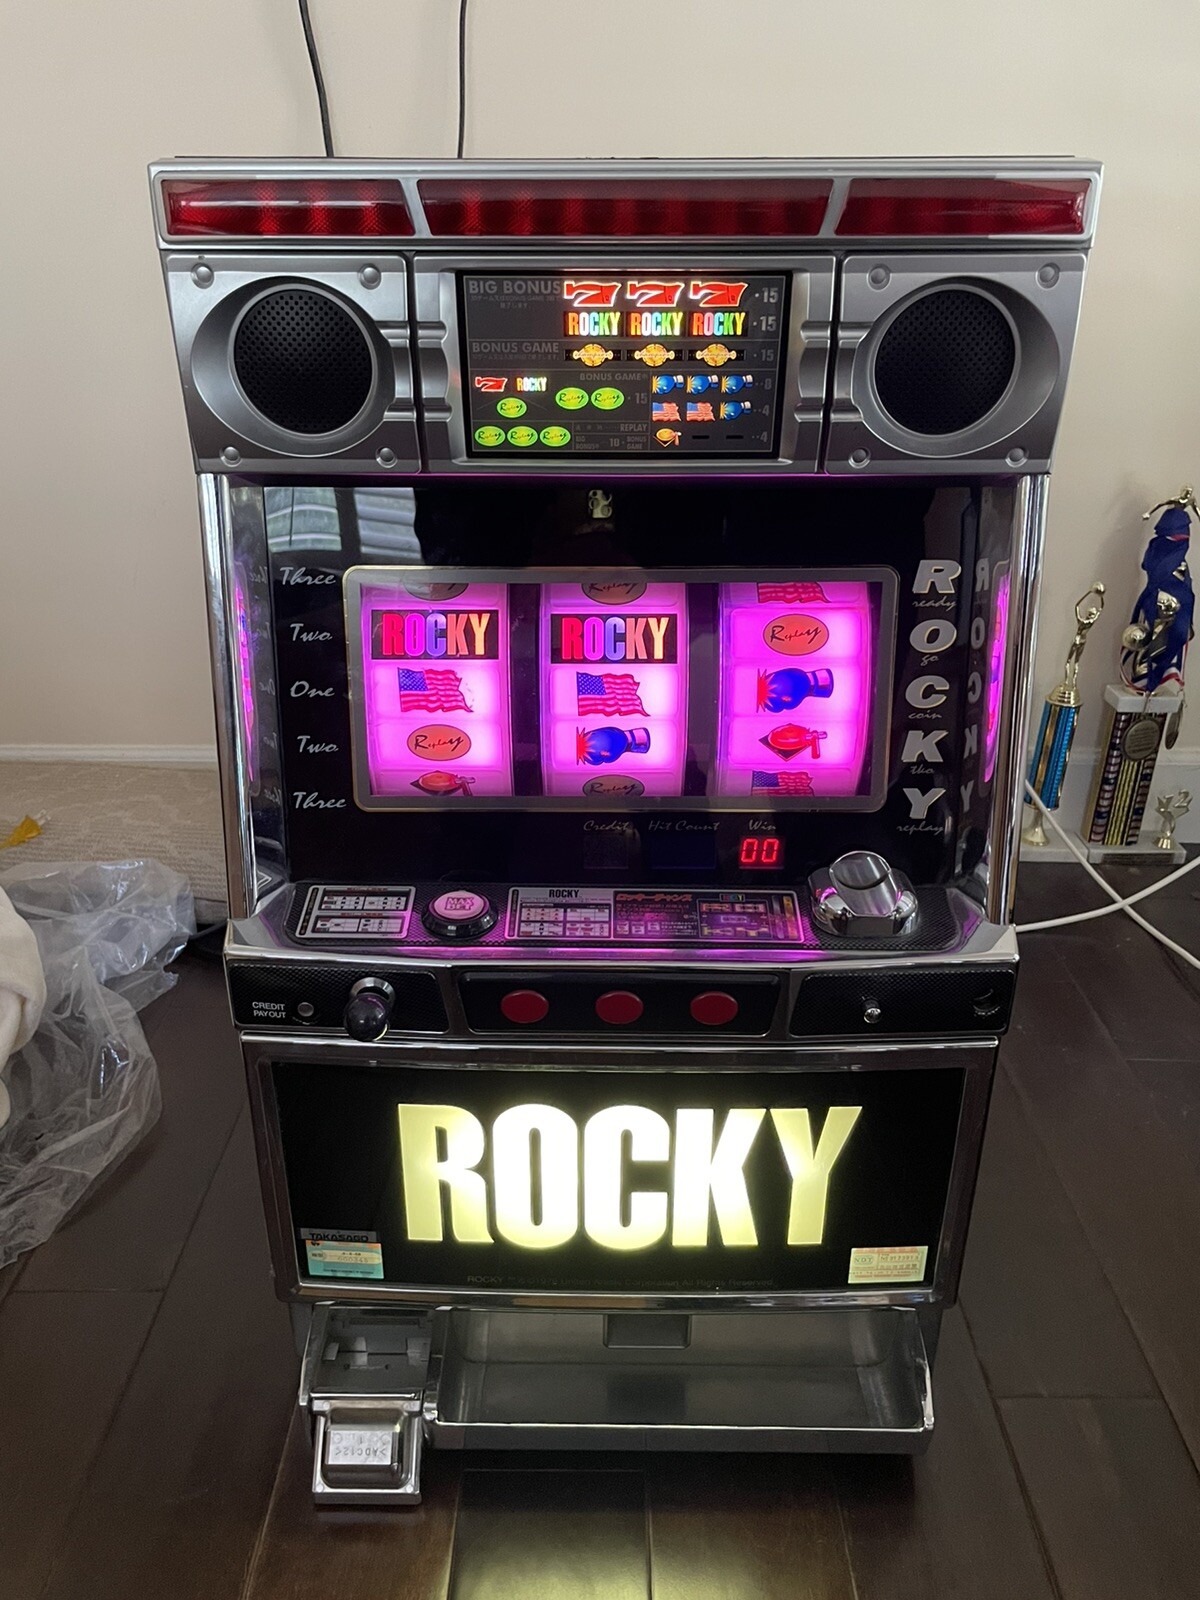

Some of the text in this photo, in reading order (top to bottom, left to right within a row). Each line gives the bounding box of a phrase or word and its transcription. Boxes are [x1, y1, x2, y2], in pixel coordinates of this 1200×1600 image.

[469, 280, 561, 294] BIG BONUS
[762, 287, 779, 303] 15
[568, 311, 777, 337] ROCKY ROCKY ROCKY 15
[472, 342, 559, 353] BONUS GAME
[760, 349, 774, 361] 15
[516, 376, 547, 392] ROCKY
[579, 373, 612, 381] BONUS
[634, 392, 648, 404] 15
[762, 404, 770, 416] 4
[620, 423, 648, 432] REPLAY
[760, 432, 768, 443] 4
[280, 566, 336, 586] Three
[912, 595, 957, 611] ready
[290, 623, 333, 642] Two
[382, 613, 491, 657] ROCKY
[561, 616, 670, 661] ROCKY
[770, 625, 822, 643] Replay
[290, 680, 335, 698] One
[296, 735, 339, 754] Two
[414, 734, 464, 752] Replay
[293, 791, 347, 809] Three
[583, 819, 776, 832] Credit Hit Count Win
[896, 820, 944, 835] replay
[740, 837, 780, 863] 00
[447, 896, 474, 905] MAX
[548, 889, 580, 898] ROCKY
[252, 1001, 286, 1011] CREDIT
[253, 1009, 287, 1019] PAYOUT
[398, 1103, 863, 1249] ROCKY
[309, 1232, 369, 1243] TAKASAGO
[467, 1275, 503, 1284] ROCKY
